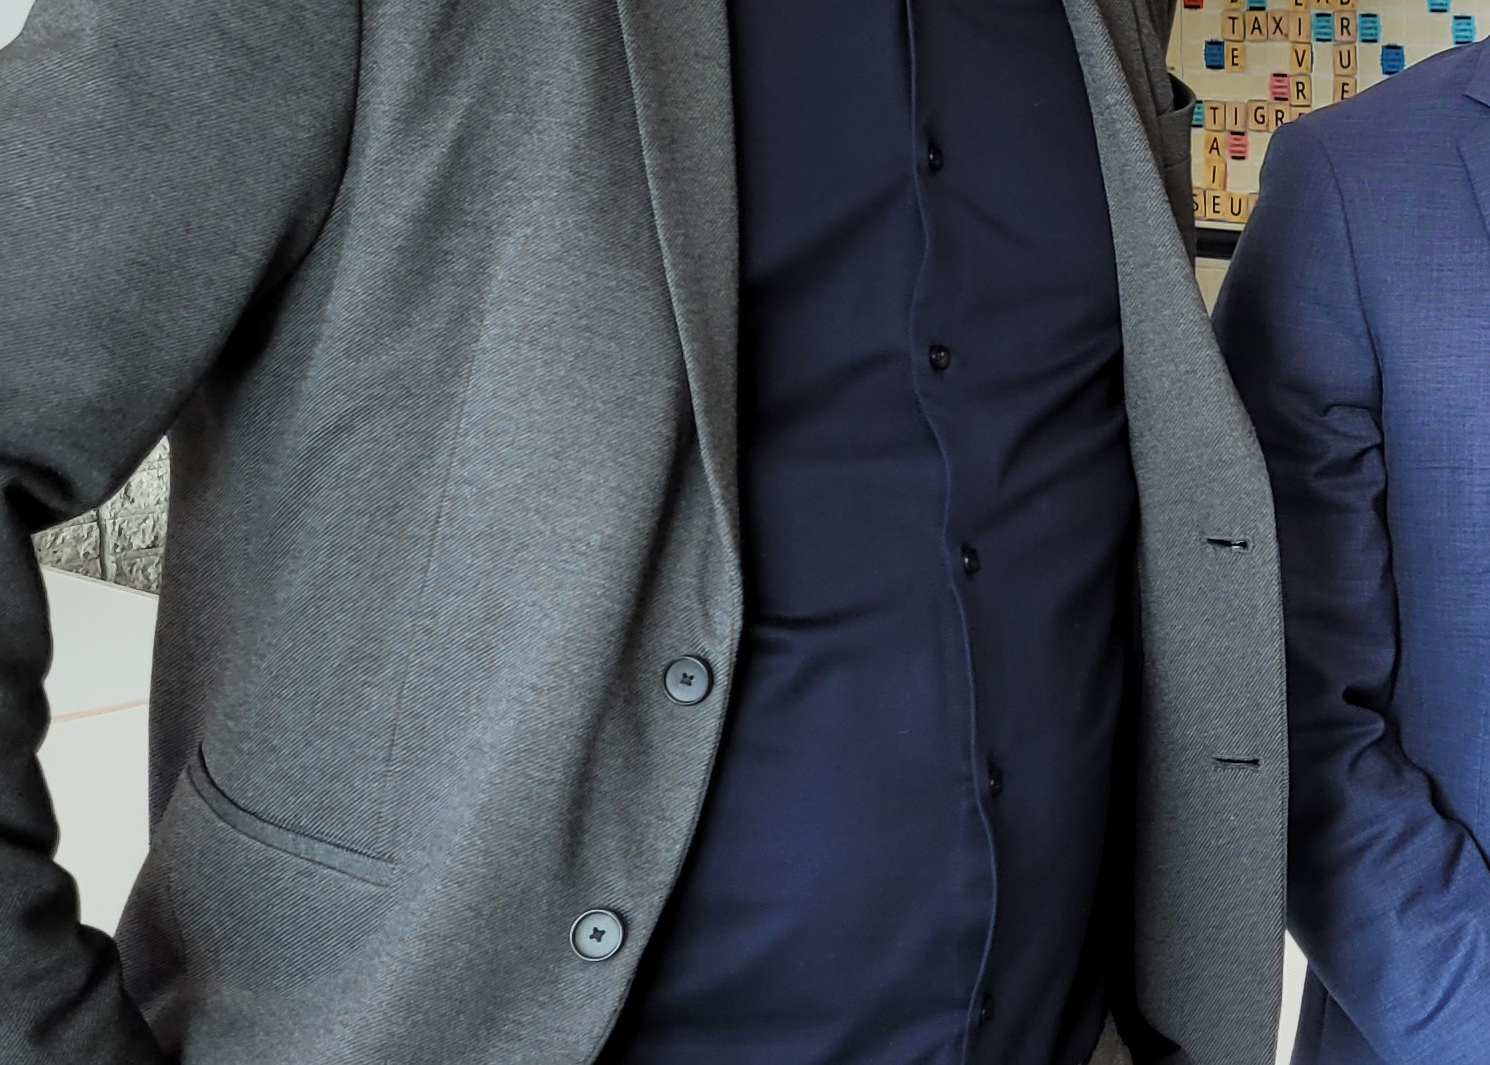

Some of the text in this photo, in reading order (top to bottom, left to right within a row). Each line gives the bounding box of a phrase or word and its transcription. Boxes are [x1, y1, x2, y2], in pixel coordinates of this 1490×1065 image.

[1227, 16, 1302, 36] TAXI
[1209, 106, 1305, 127] TIGR
[1192, 193, 1242, 217] SEU
